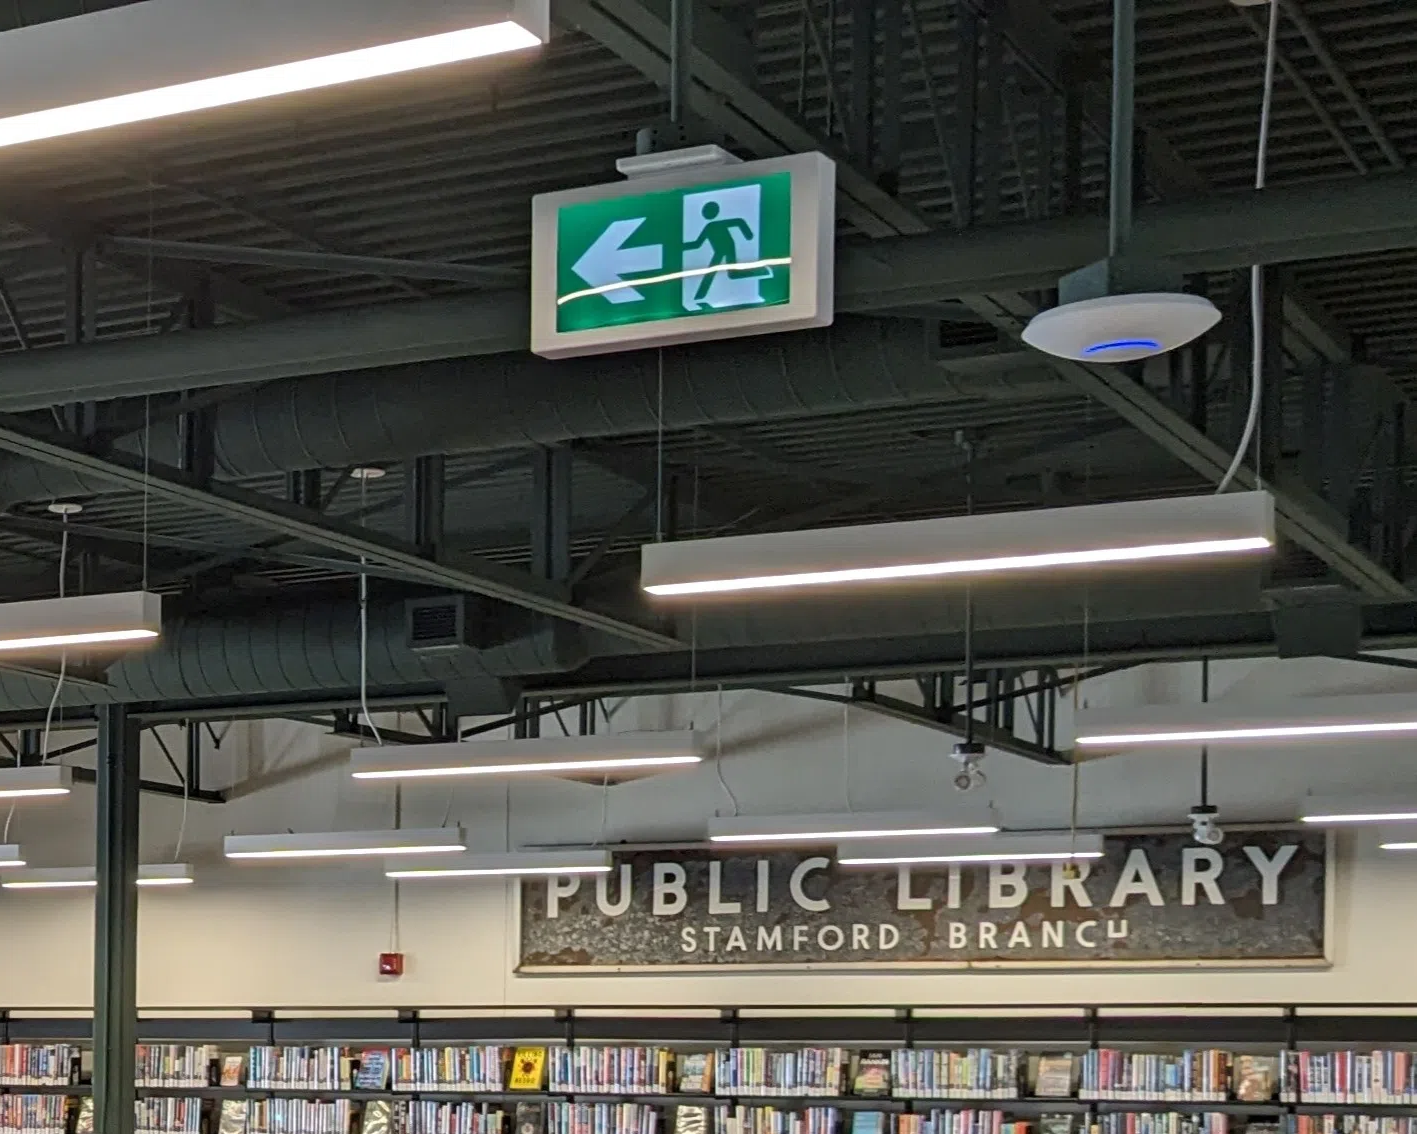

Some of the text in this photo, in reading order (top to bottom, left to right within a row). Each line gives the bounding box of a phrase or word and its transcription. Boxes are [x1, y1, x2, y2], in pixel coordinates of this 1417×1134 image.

[546, 845, 1298, 919] PUBLIC LIBRARY
[681, 924, 900, 952] STAMFORD
